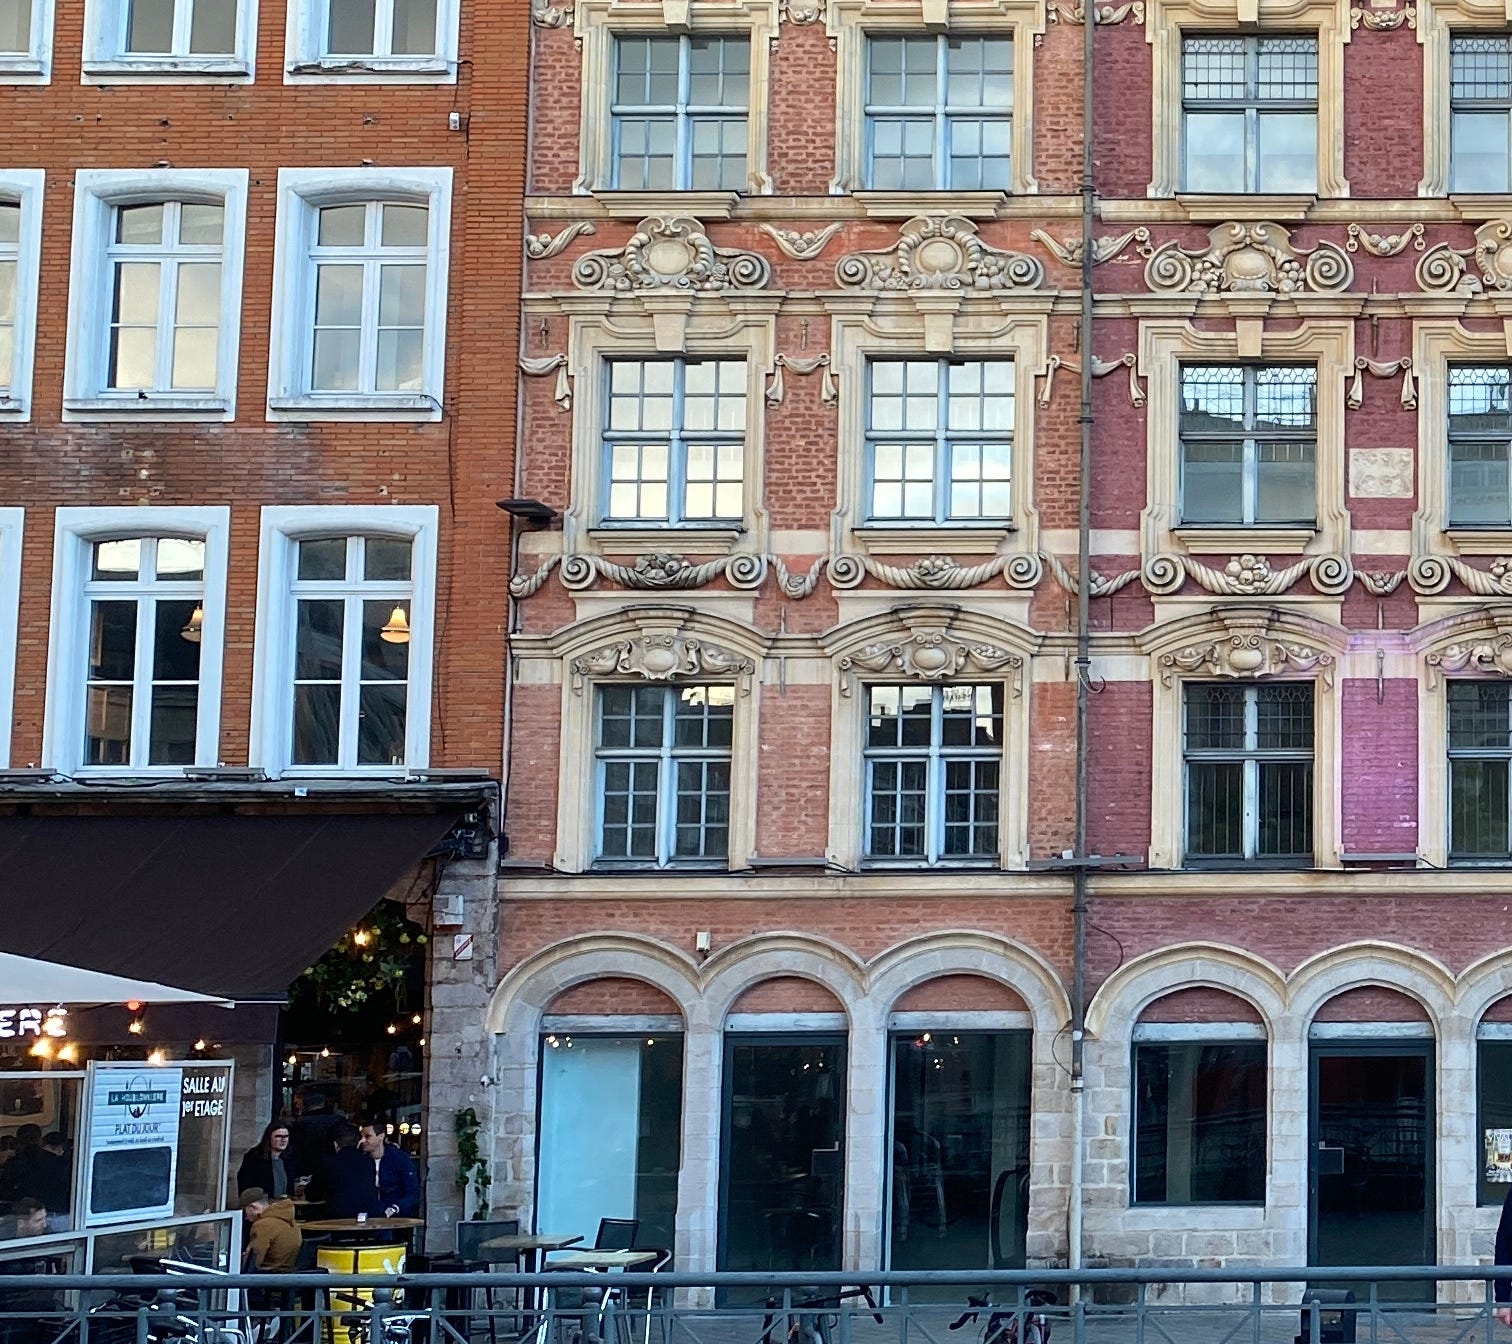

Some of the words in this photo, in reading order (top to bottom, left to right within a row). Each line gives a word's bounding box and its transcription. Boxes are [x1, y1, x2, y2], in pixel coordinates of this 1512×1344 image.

[183, 1077, 210, 1094] SALLE
[212, 1076, 225, 1093] AU
[194, 1099, 223, 1117] ETAGE
